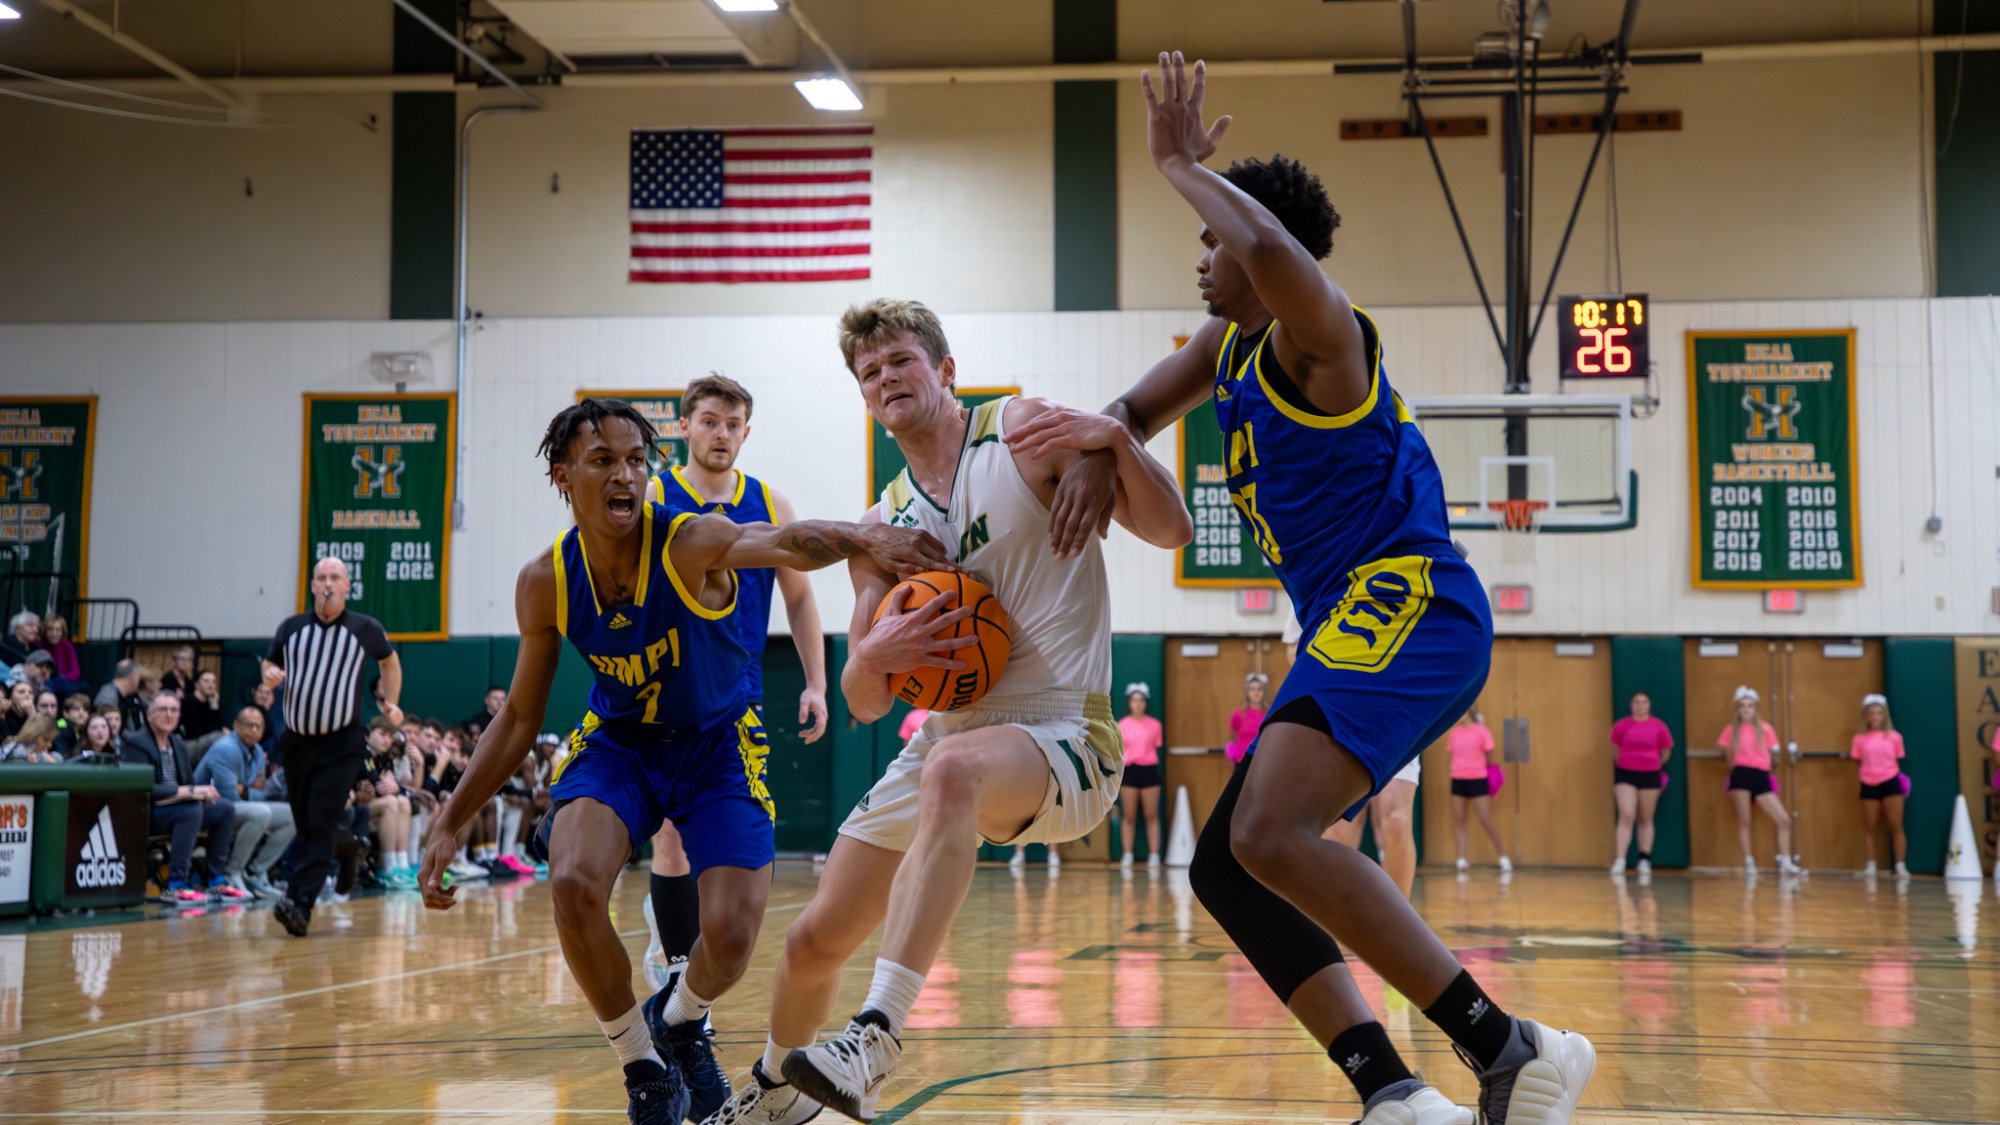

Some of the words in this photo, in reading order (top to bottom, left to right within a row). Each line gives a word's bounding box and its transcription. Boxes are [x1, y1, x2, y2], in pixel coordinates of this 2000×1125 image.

[1573, 300, 1643, 328] 10:17
[1577, 328, 1632, 373] 26
[1745, 343, 1793, 361] NCAA
[1707, 362, 1833, 382] TOURNAMENT
[358, 405, 402, 422] NCAA
[0, 427, 76, 446] NAMENT
[322, 423, 437, 442] TOURNAMENT
[1713, 463, 1836, 482] BASKETBALL
[1193, 487, 1232, 506] 200
[1710, 486, 1763, 506] 2004
[1786, 486, 1836, 506] 2010
[332, 510, 421, 529] BASEBALL
[1714, 510, 1760, 529] 2011
[1788, 510, 1837, 529] 2016
[1194, 527, 1242, 546] 2016
[1712, 530, 1761, 550] 2017
[316, 541, 365, 561] 2009
[391, 541, 432, 561] 2011
[1195, 547, 1242, 566] 2019
[1713, 552, 1762, 571] 2019
[1788, 551, 1842, 570] 2020
[386, 561, 435, 581] 2022
[76, 856, 126, 888] adidas
